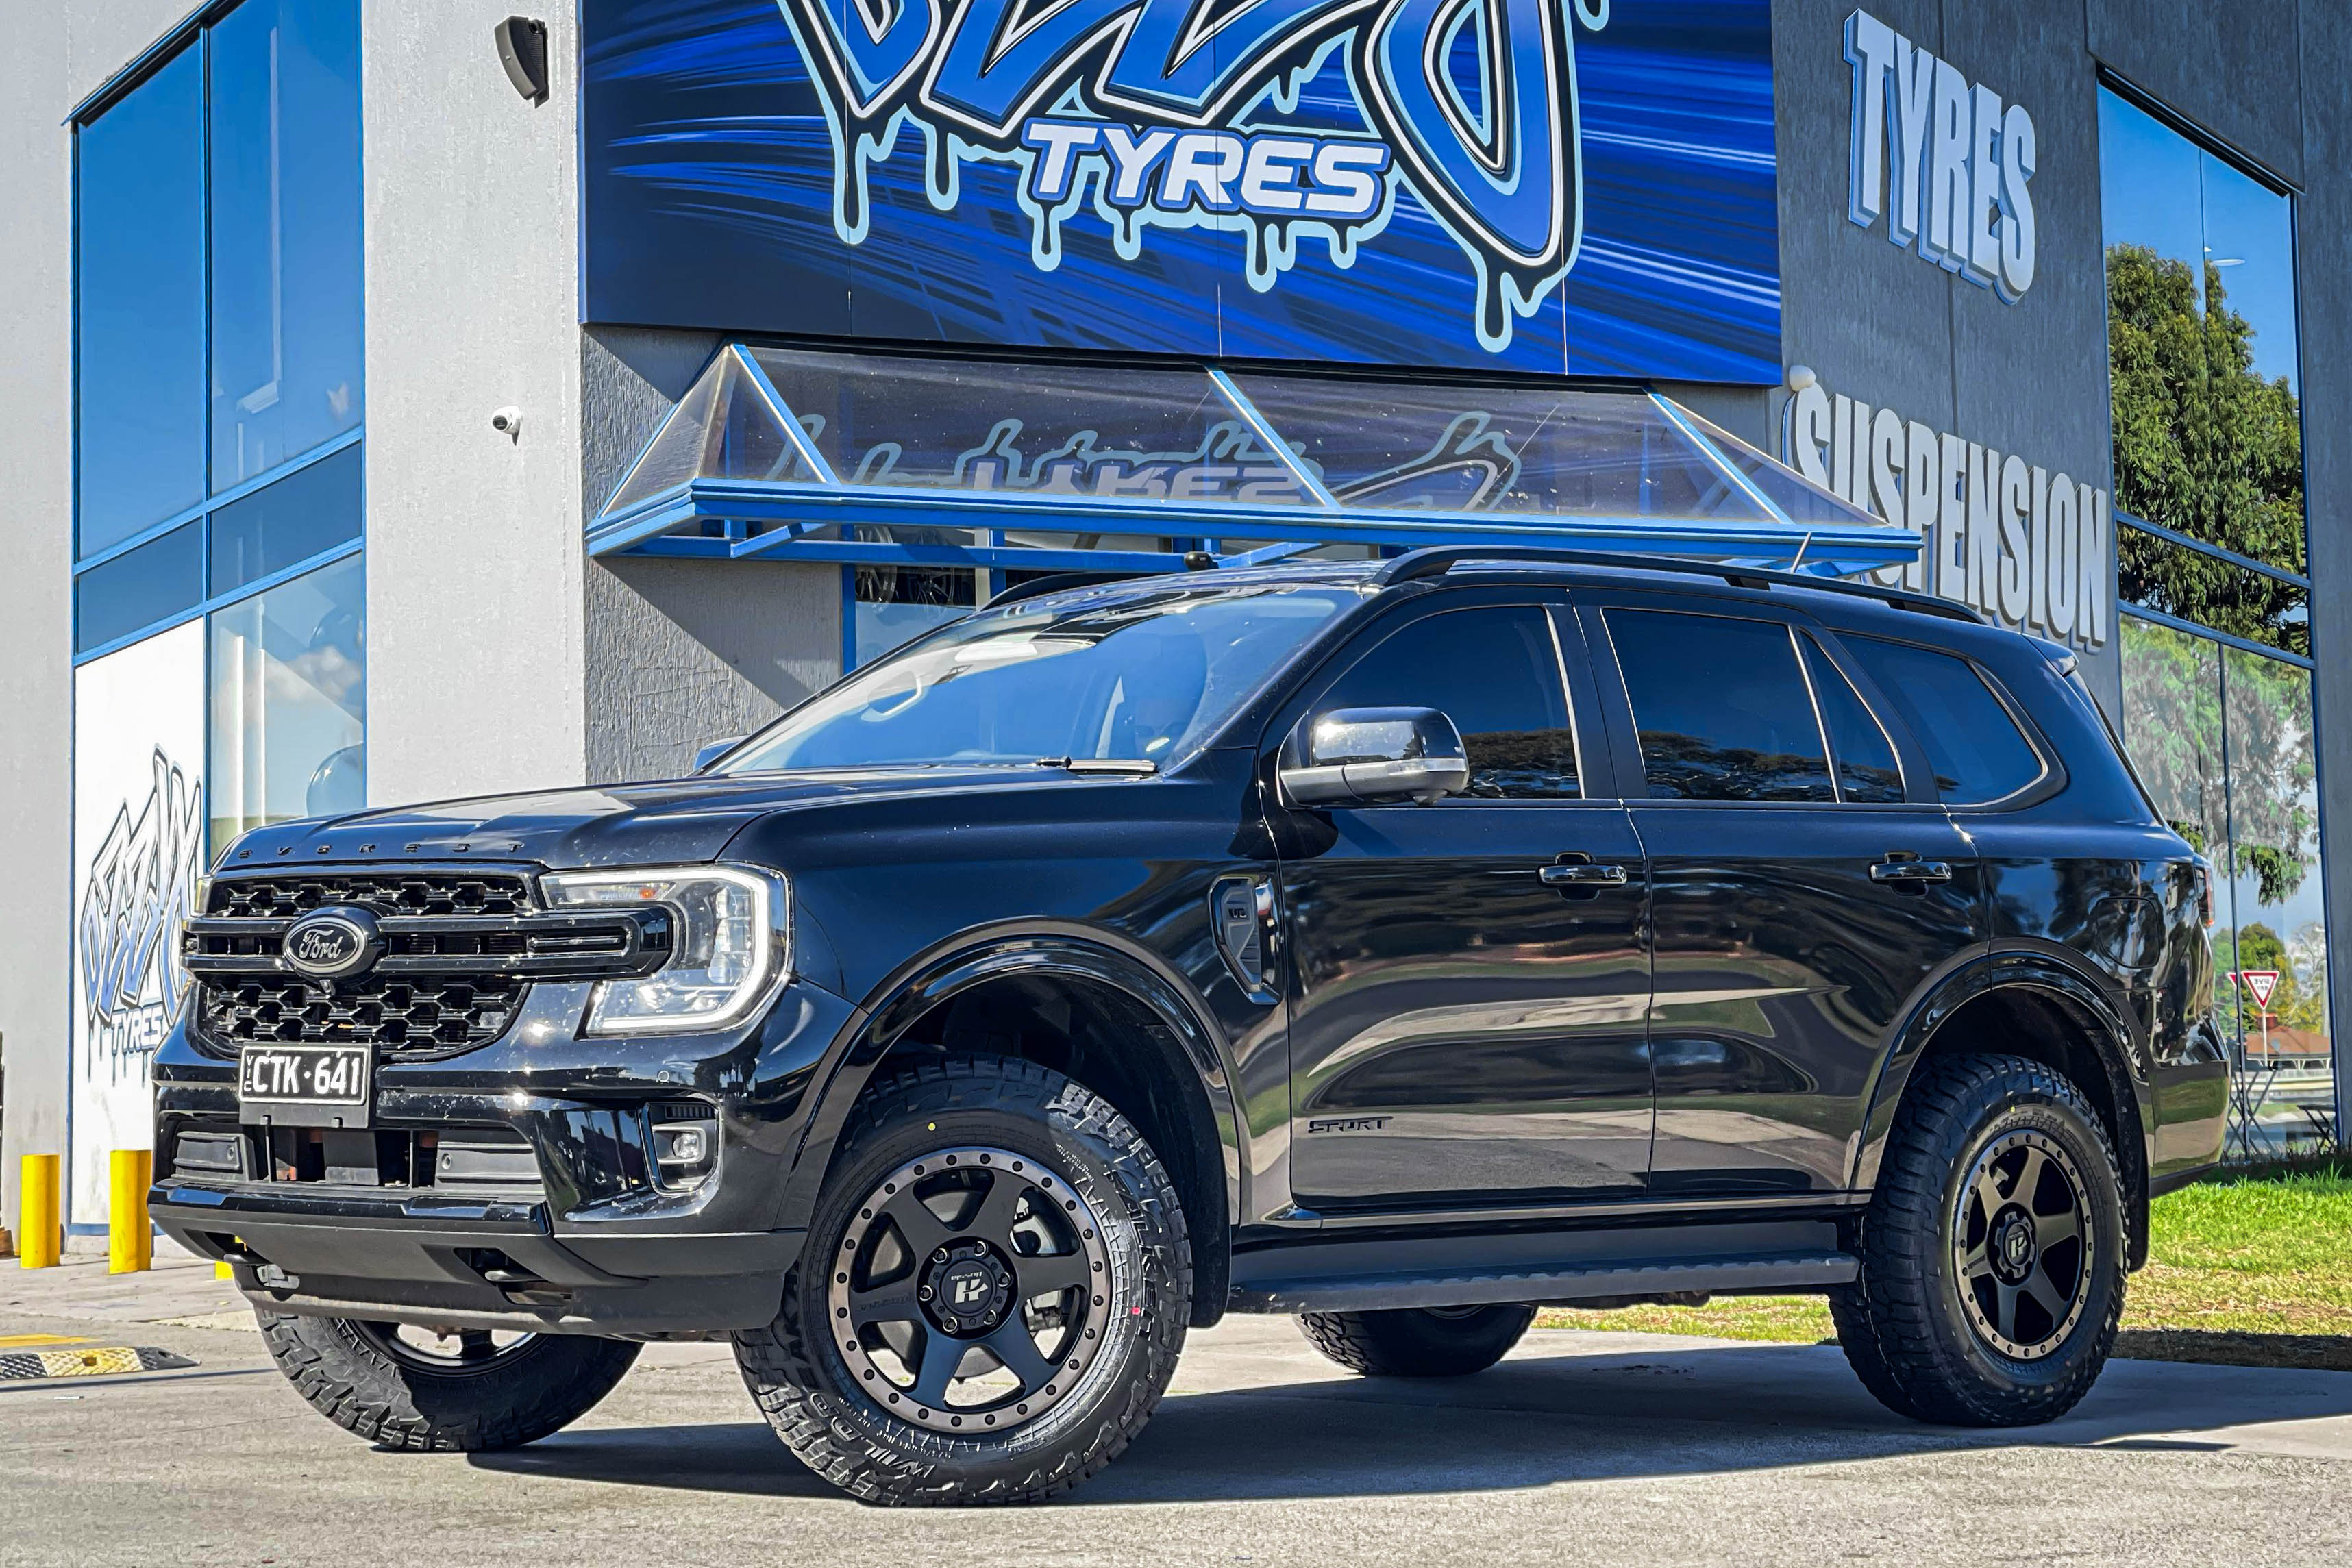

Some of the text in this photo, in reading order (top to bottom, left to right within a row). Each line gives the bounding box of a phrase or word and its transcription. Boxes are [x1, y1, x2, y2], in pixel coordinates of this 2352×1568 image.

[1026, 123, 1387, 215] TYRES
[1844, 8, 2036, 306] TYRES
[1783, 379, 2107, 655] SUSPENSION
[299, 928, 343, 958] Ford
[111, 1003, 165, 1054] TYRES
[244, 1055, 254, 1091] VIC
[1308, 1116, 1394, 1133] SPORT
